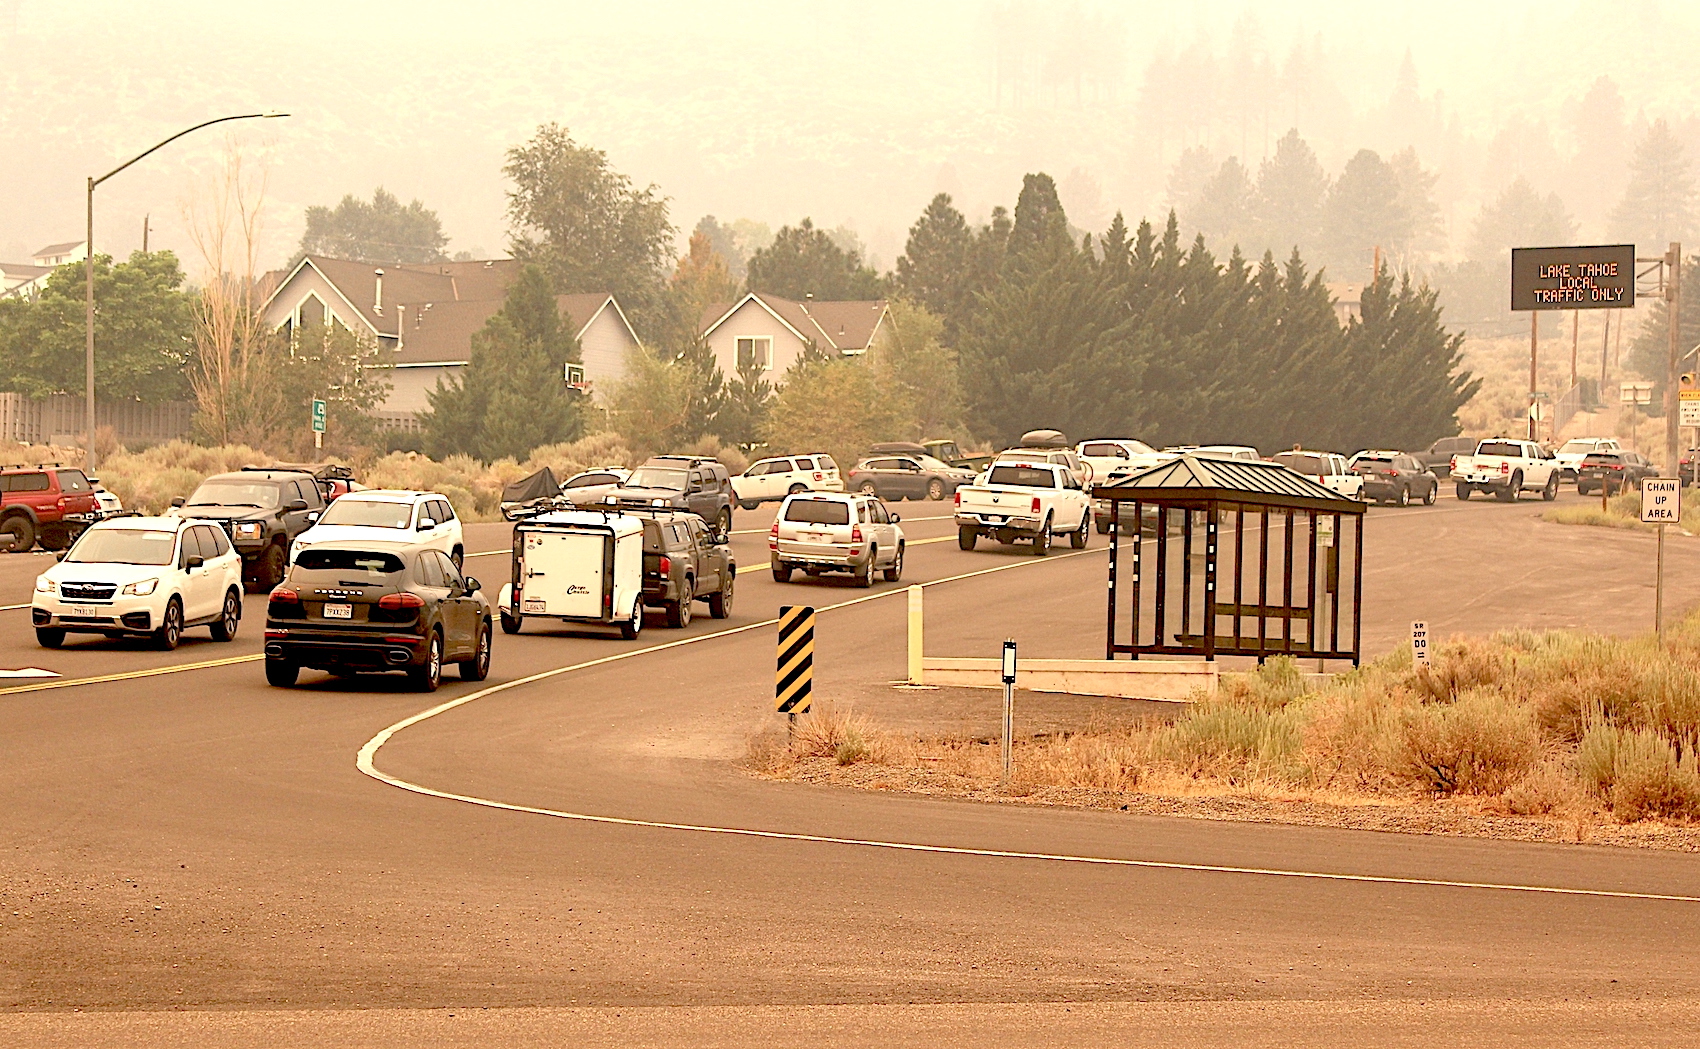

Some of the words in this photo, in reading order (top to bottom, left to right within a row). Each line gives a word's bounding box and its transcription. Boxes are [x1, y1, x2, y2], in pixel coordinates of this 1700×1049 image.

[1540, 264, 1571, 278] LAKE
[1578, 262, 1618, 276] TAHOE
[1560, 276, 1598, 290] LOCAL
[1533, 289, 1584, 303] TRAFFIC
[1591, 287, 1624, 301] ONLY
[1647, 483, 1675, 491] CHAIN
[1655, 496, 1667, 505] UP
[1647, 509, 1673, 518] AREA
